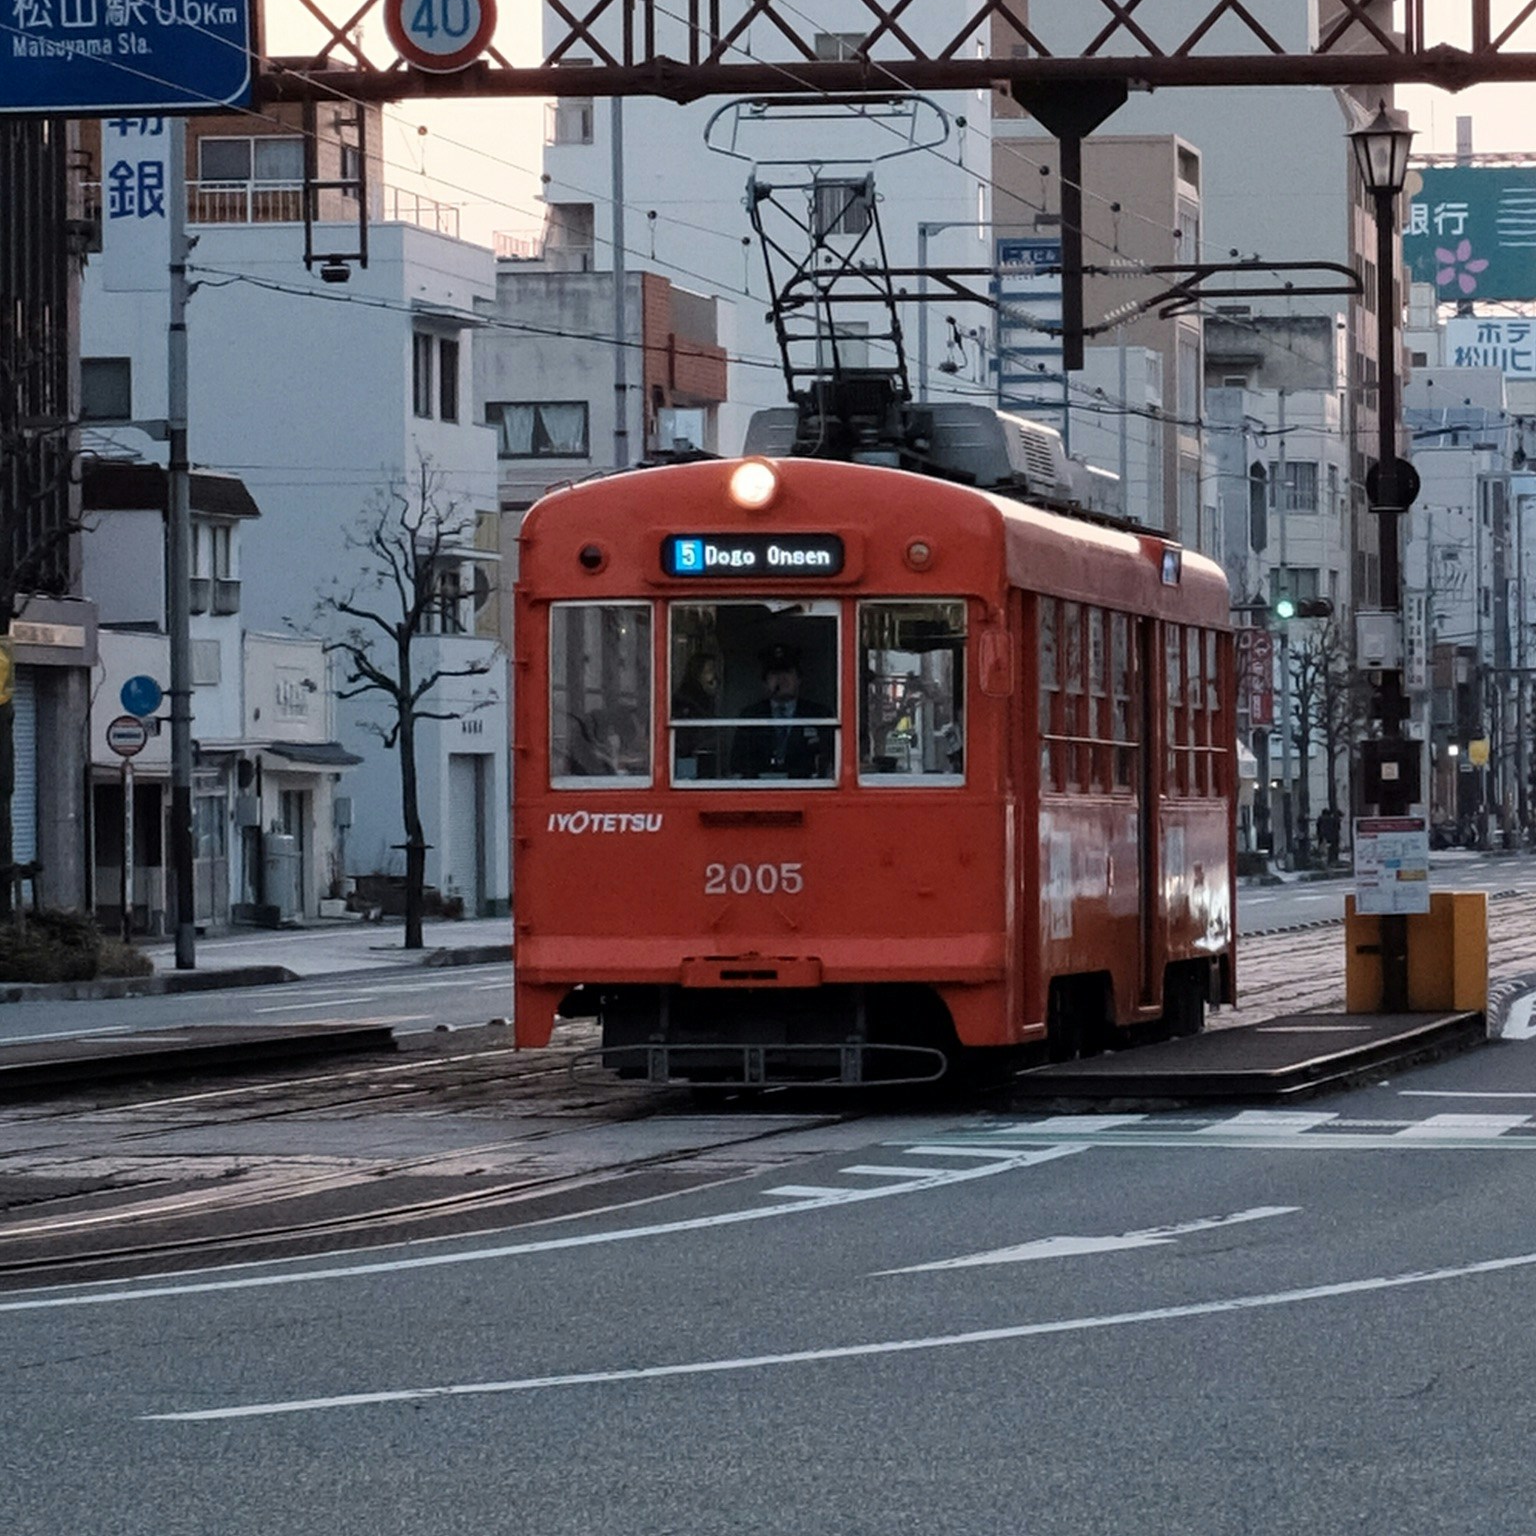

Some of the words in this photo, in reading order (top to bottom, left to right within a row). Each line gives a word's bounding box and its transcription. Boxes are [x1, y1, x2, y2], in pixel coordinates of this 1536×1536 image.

[13, 35, 113, 61] Matsuyama
[118, 31, 152, 56] Sta.
[681, 542, 696, 566] 5
[704, 545, 756, 566] Dogo
[767, 545, 831, 565] Onsen
[547, 810, 663, 834] IYOTETSU
[704, 863, 803, 895] 2005
